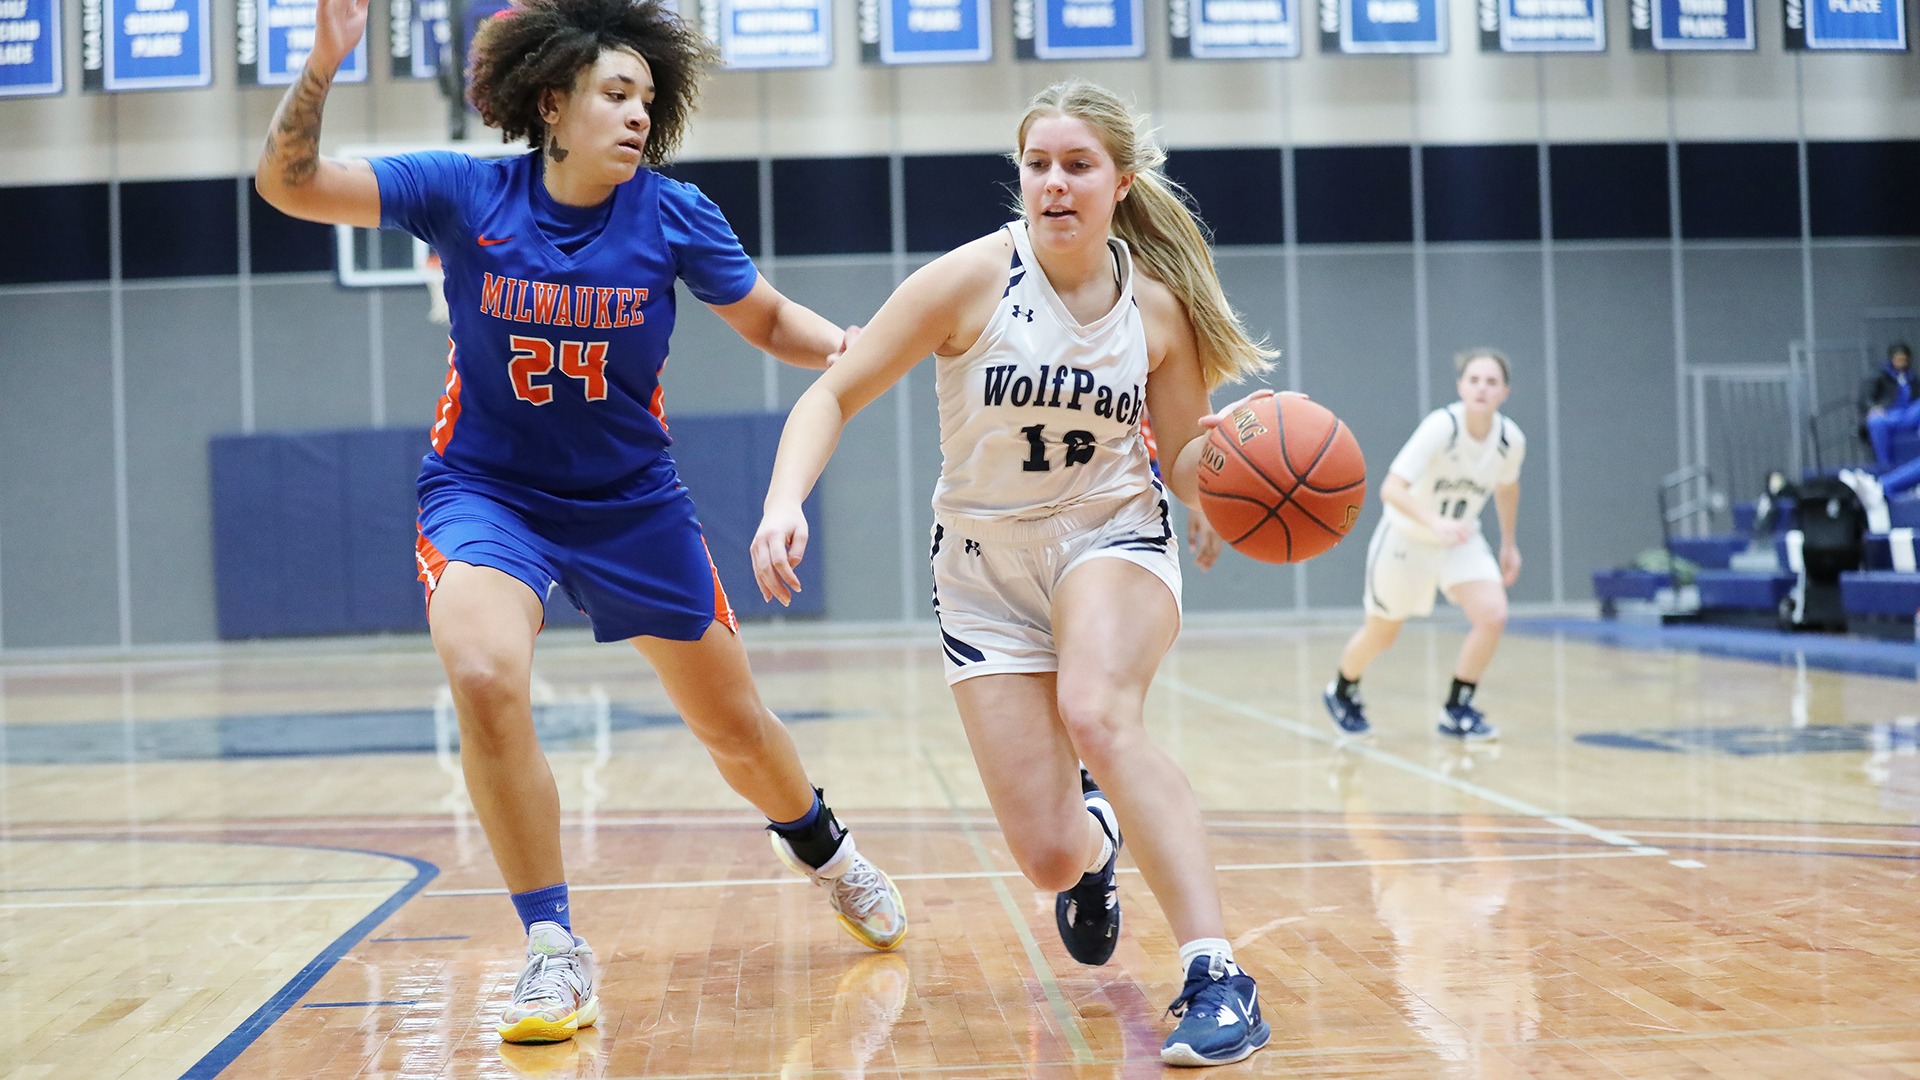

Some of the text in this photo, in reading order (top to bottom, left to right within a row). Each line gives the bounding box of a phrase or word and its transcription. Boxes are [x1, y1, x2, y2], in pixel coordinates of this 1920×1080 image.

[480, 271, 649, 329] MILWAUKEE
[508, 334, 609, 407] 24
[984, 364, 1142, 427] WolfPack
